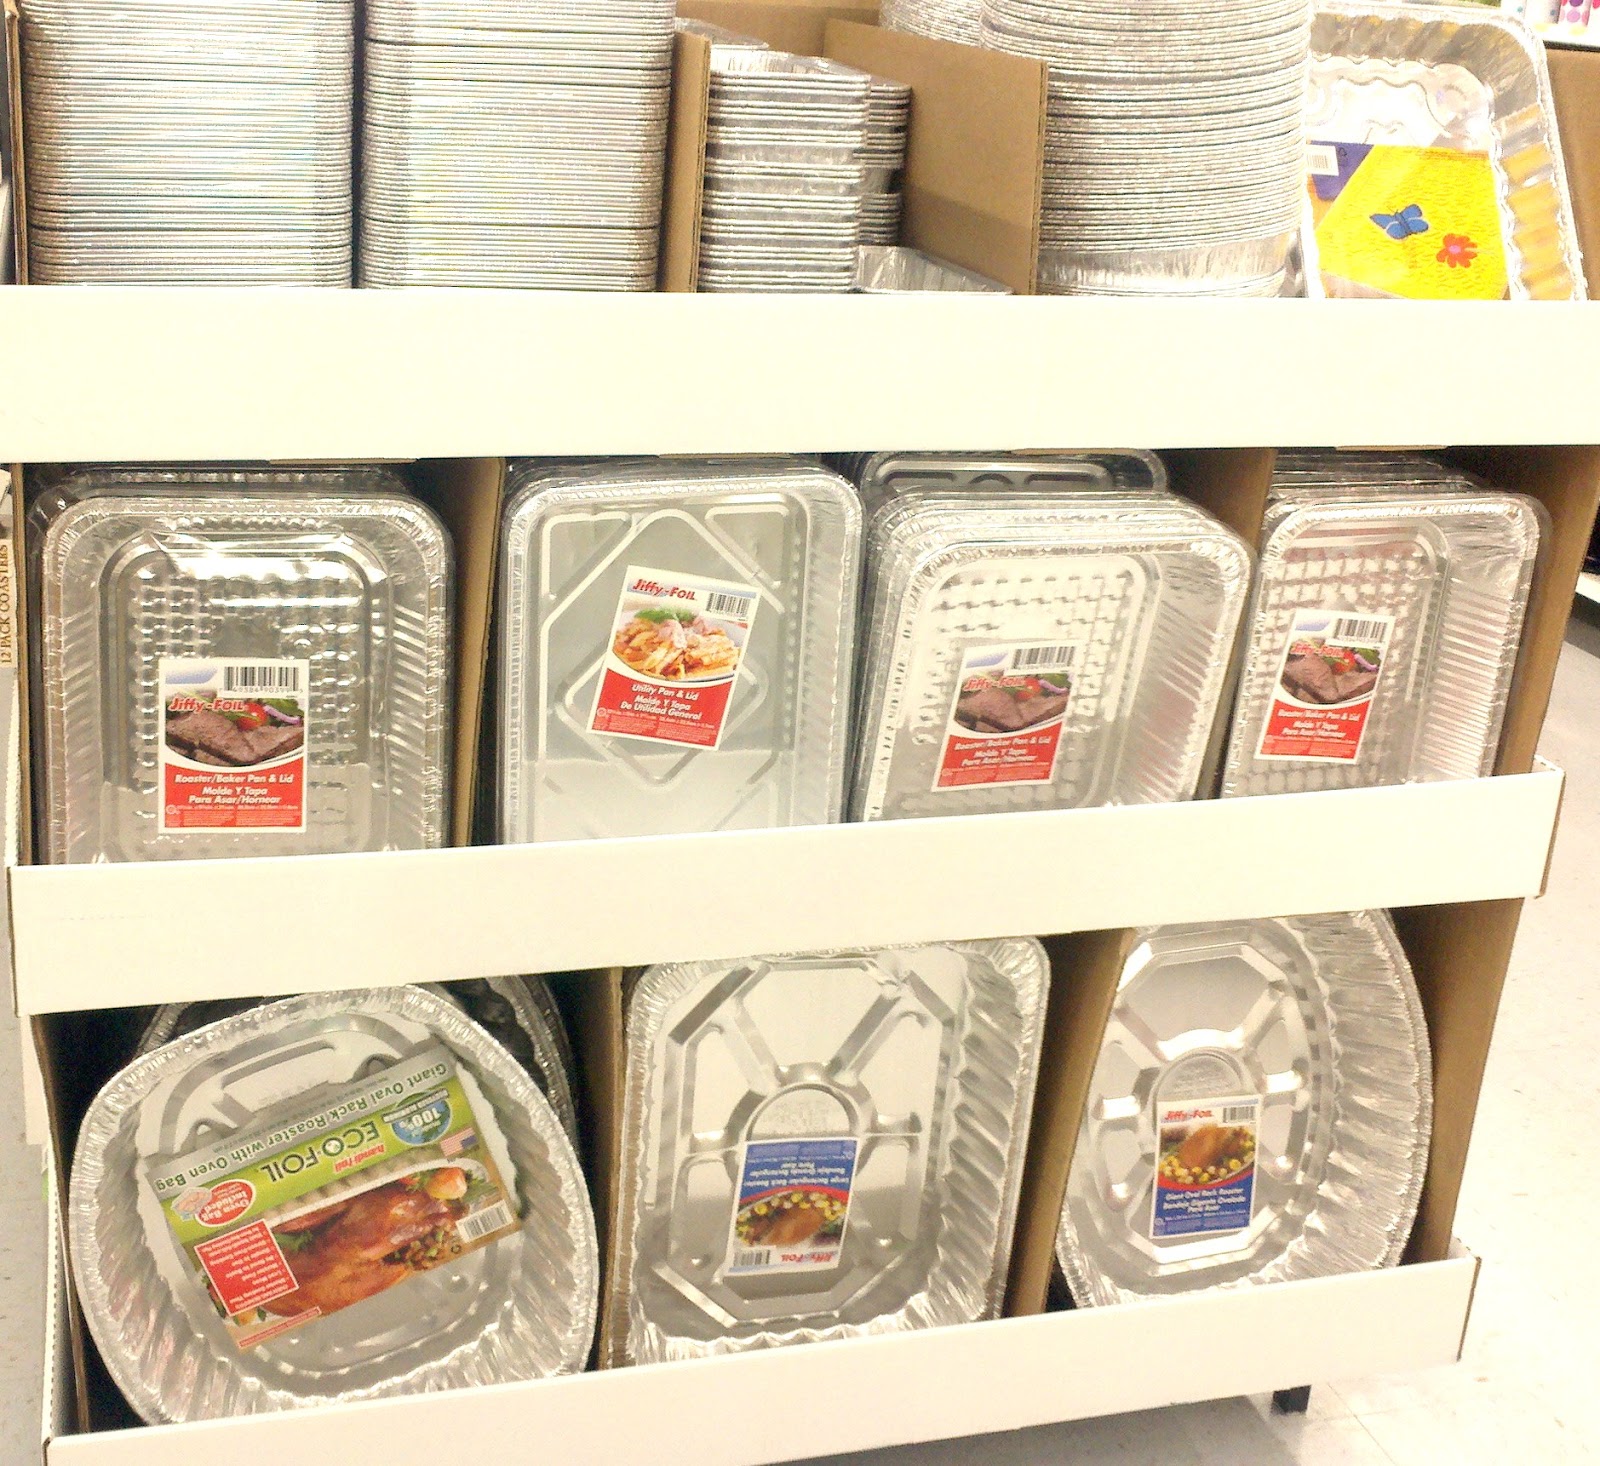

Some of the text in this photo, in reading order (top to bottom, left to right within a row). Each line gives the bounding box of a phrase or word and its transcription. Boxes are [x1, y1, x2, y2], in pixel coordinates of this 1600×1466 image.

[1, 616, 11, 650] PACK
[2, 652, 11, 664] 12
[632, 684, 699, 700] Utility Pan & Lid
[620, 701, 632, 710] De
[634, 703, 667, 715] Utilidad
[668, 708, 702, 720] General
[634, 695, 660, 706] Molde
[671, 700, 691, 711] Tapa
[175, 773, 294, 783] Roaster/Baker Pan & Lid
[188, 795, 282, 805] Para Asar/Hornear
[202, 786, 268, 797] Molde Y Tapa
[406, 1063, 447, 1087] Giant
[370, 1082, 404, 1102] Oval
[328, 1097, 367, 1120] Rack
[398, 1108, 441, 1129] 100%
[266, 1115, 325, 1146] Roaster
[230, 1141, 263, 1162] with
[189, 1156, 227, 1179] Oven
[154, 1172, 186, 1193] Bag
[201, 1199, 249, 1221] Oven Bag
[204, 1190, 247, 1213] Included
